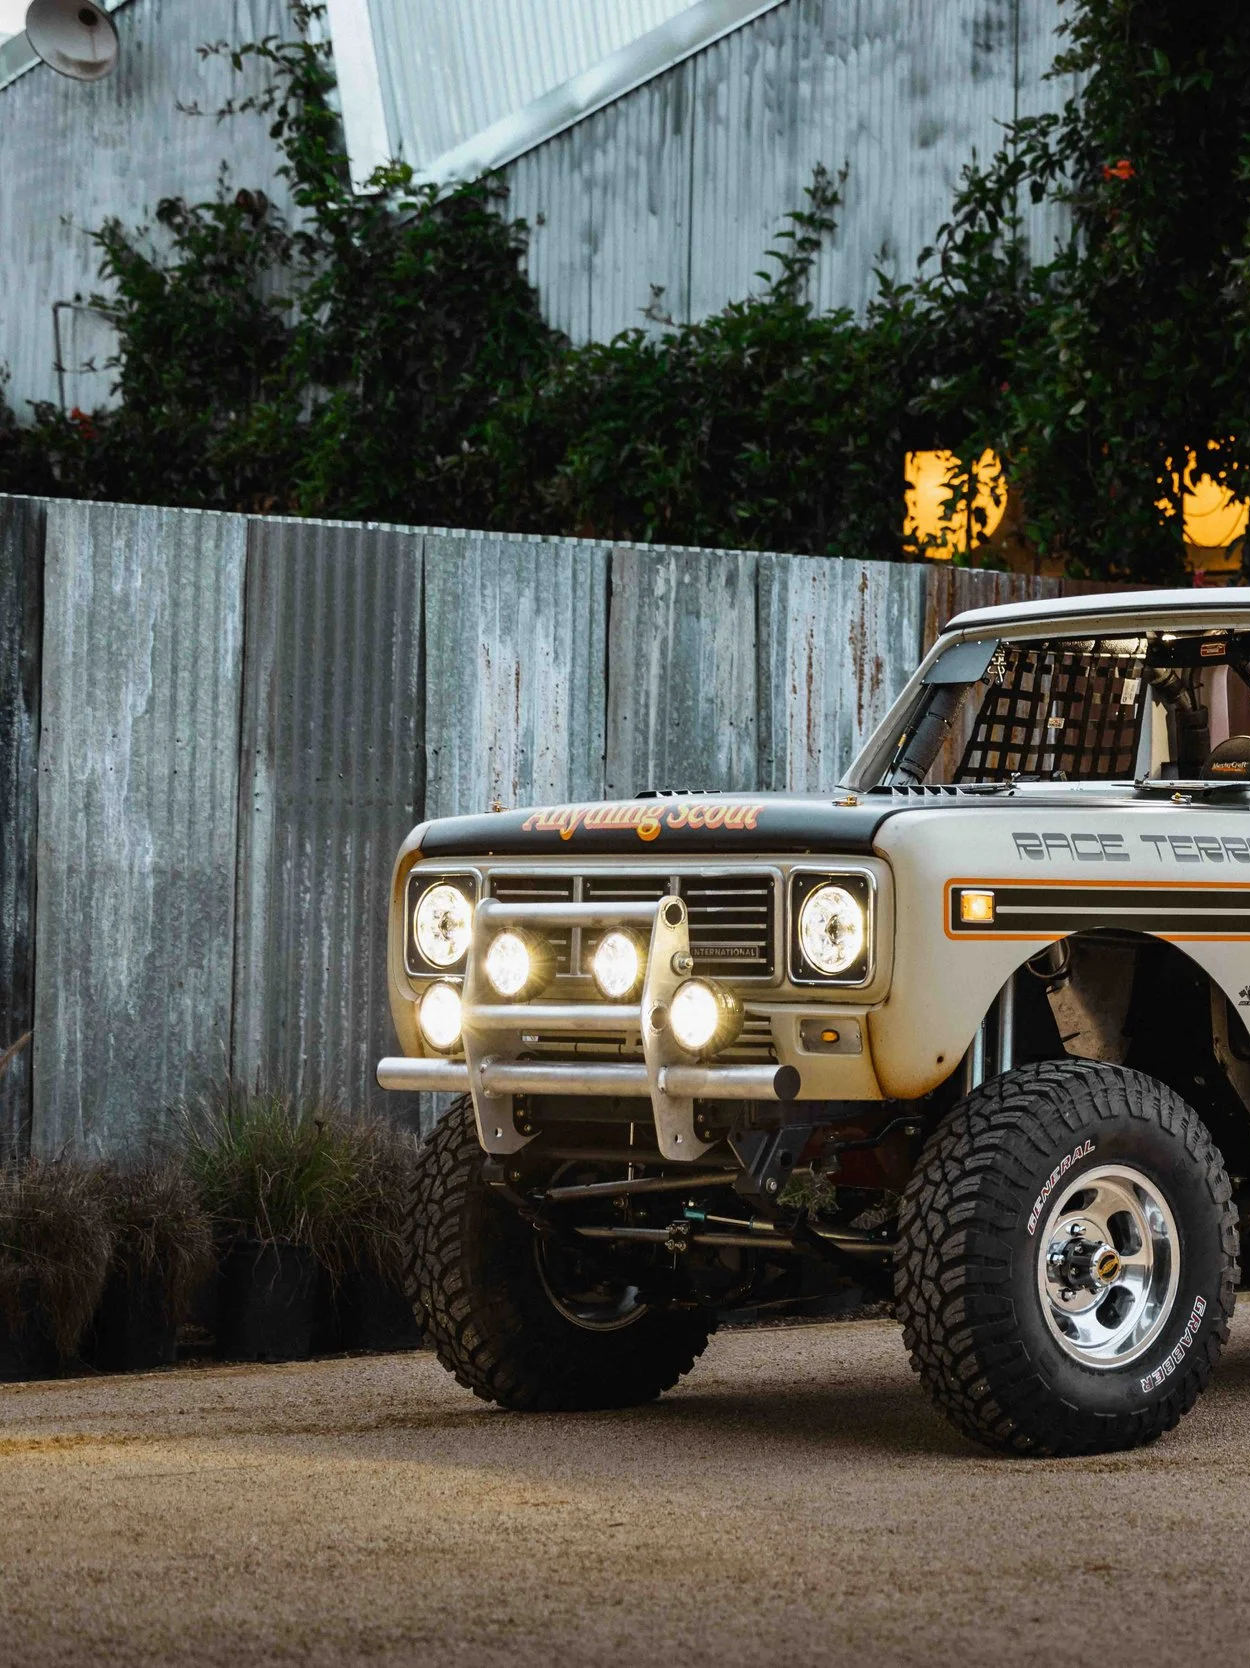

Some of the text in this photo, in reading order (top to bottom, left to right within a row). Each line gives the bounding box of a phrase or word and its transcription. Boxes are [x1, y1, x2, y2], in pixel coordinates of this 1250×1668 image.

[522, 803, 764, 841] Anything Scout
[1012, 832, 1131, 861] RACE
[1028, 1140, 1096, 1236] GENERAL
[1142, 1296, 1207, 1393] GRABBER
